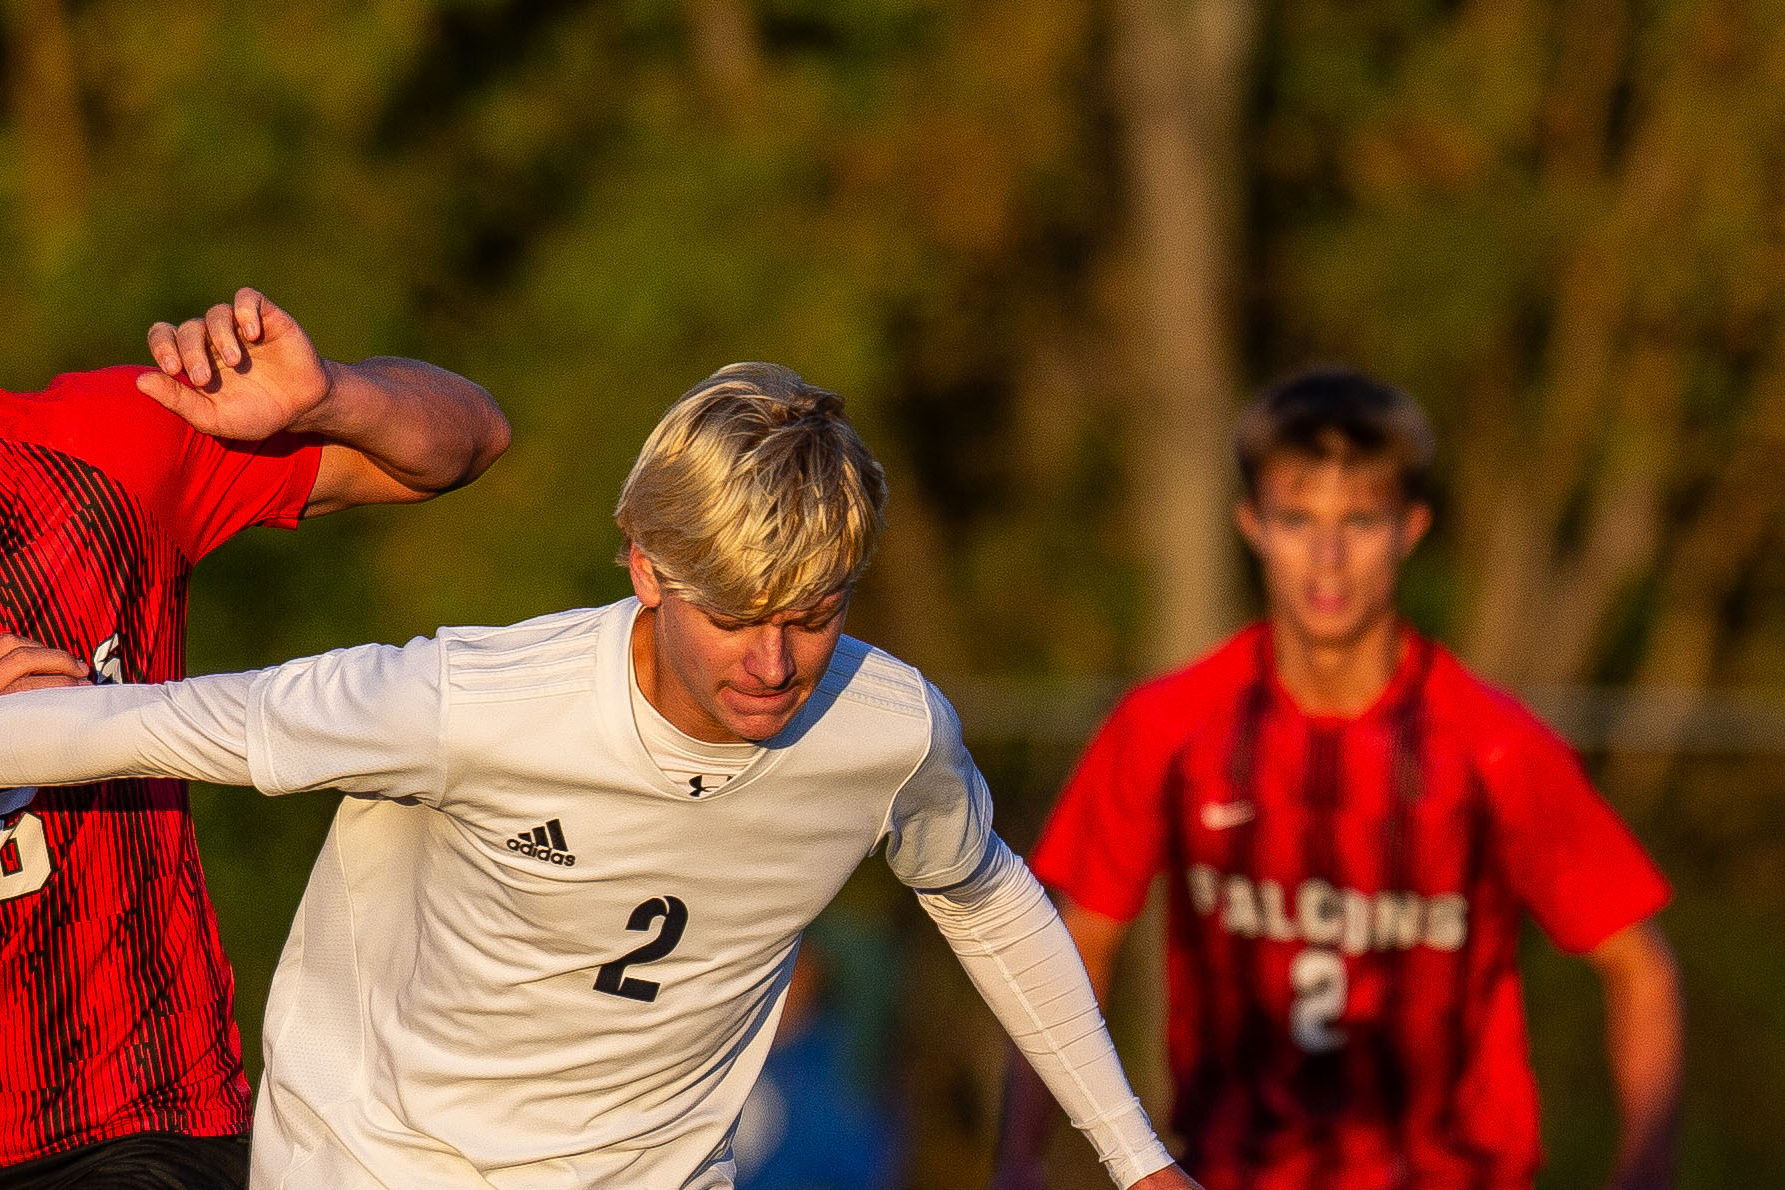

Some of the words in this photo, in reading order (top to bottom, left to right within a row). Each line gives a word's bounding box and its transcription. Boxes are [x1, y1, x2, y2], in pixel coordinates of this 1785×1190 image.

[506, 838, 576, 867] adidas
[592, 895, 689, 1004] 2
[1288, 947, 1350, 1051] 2
